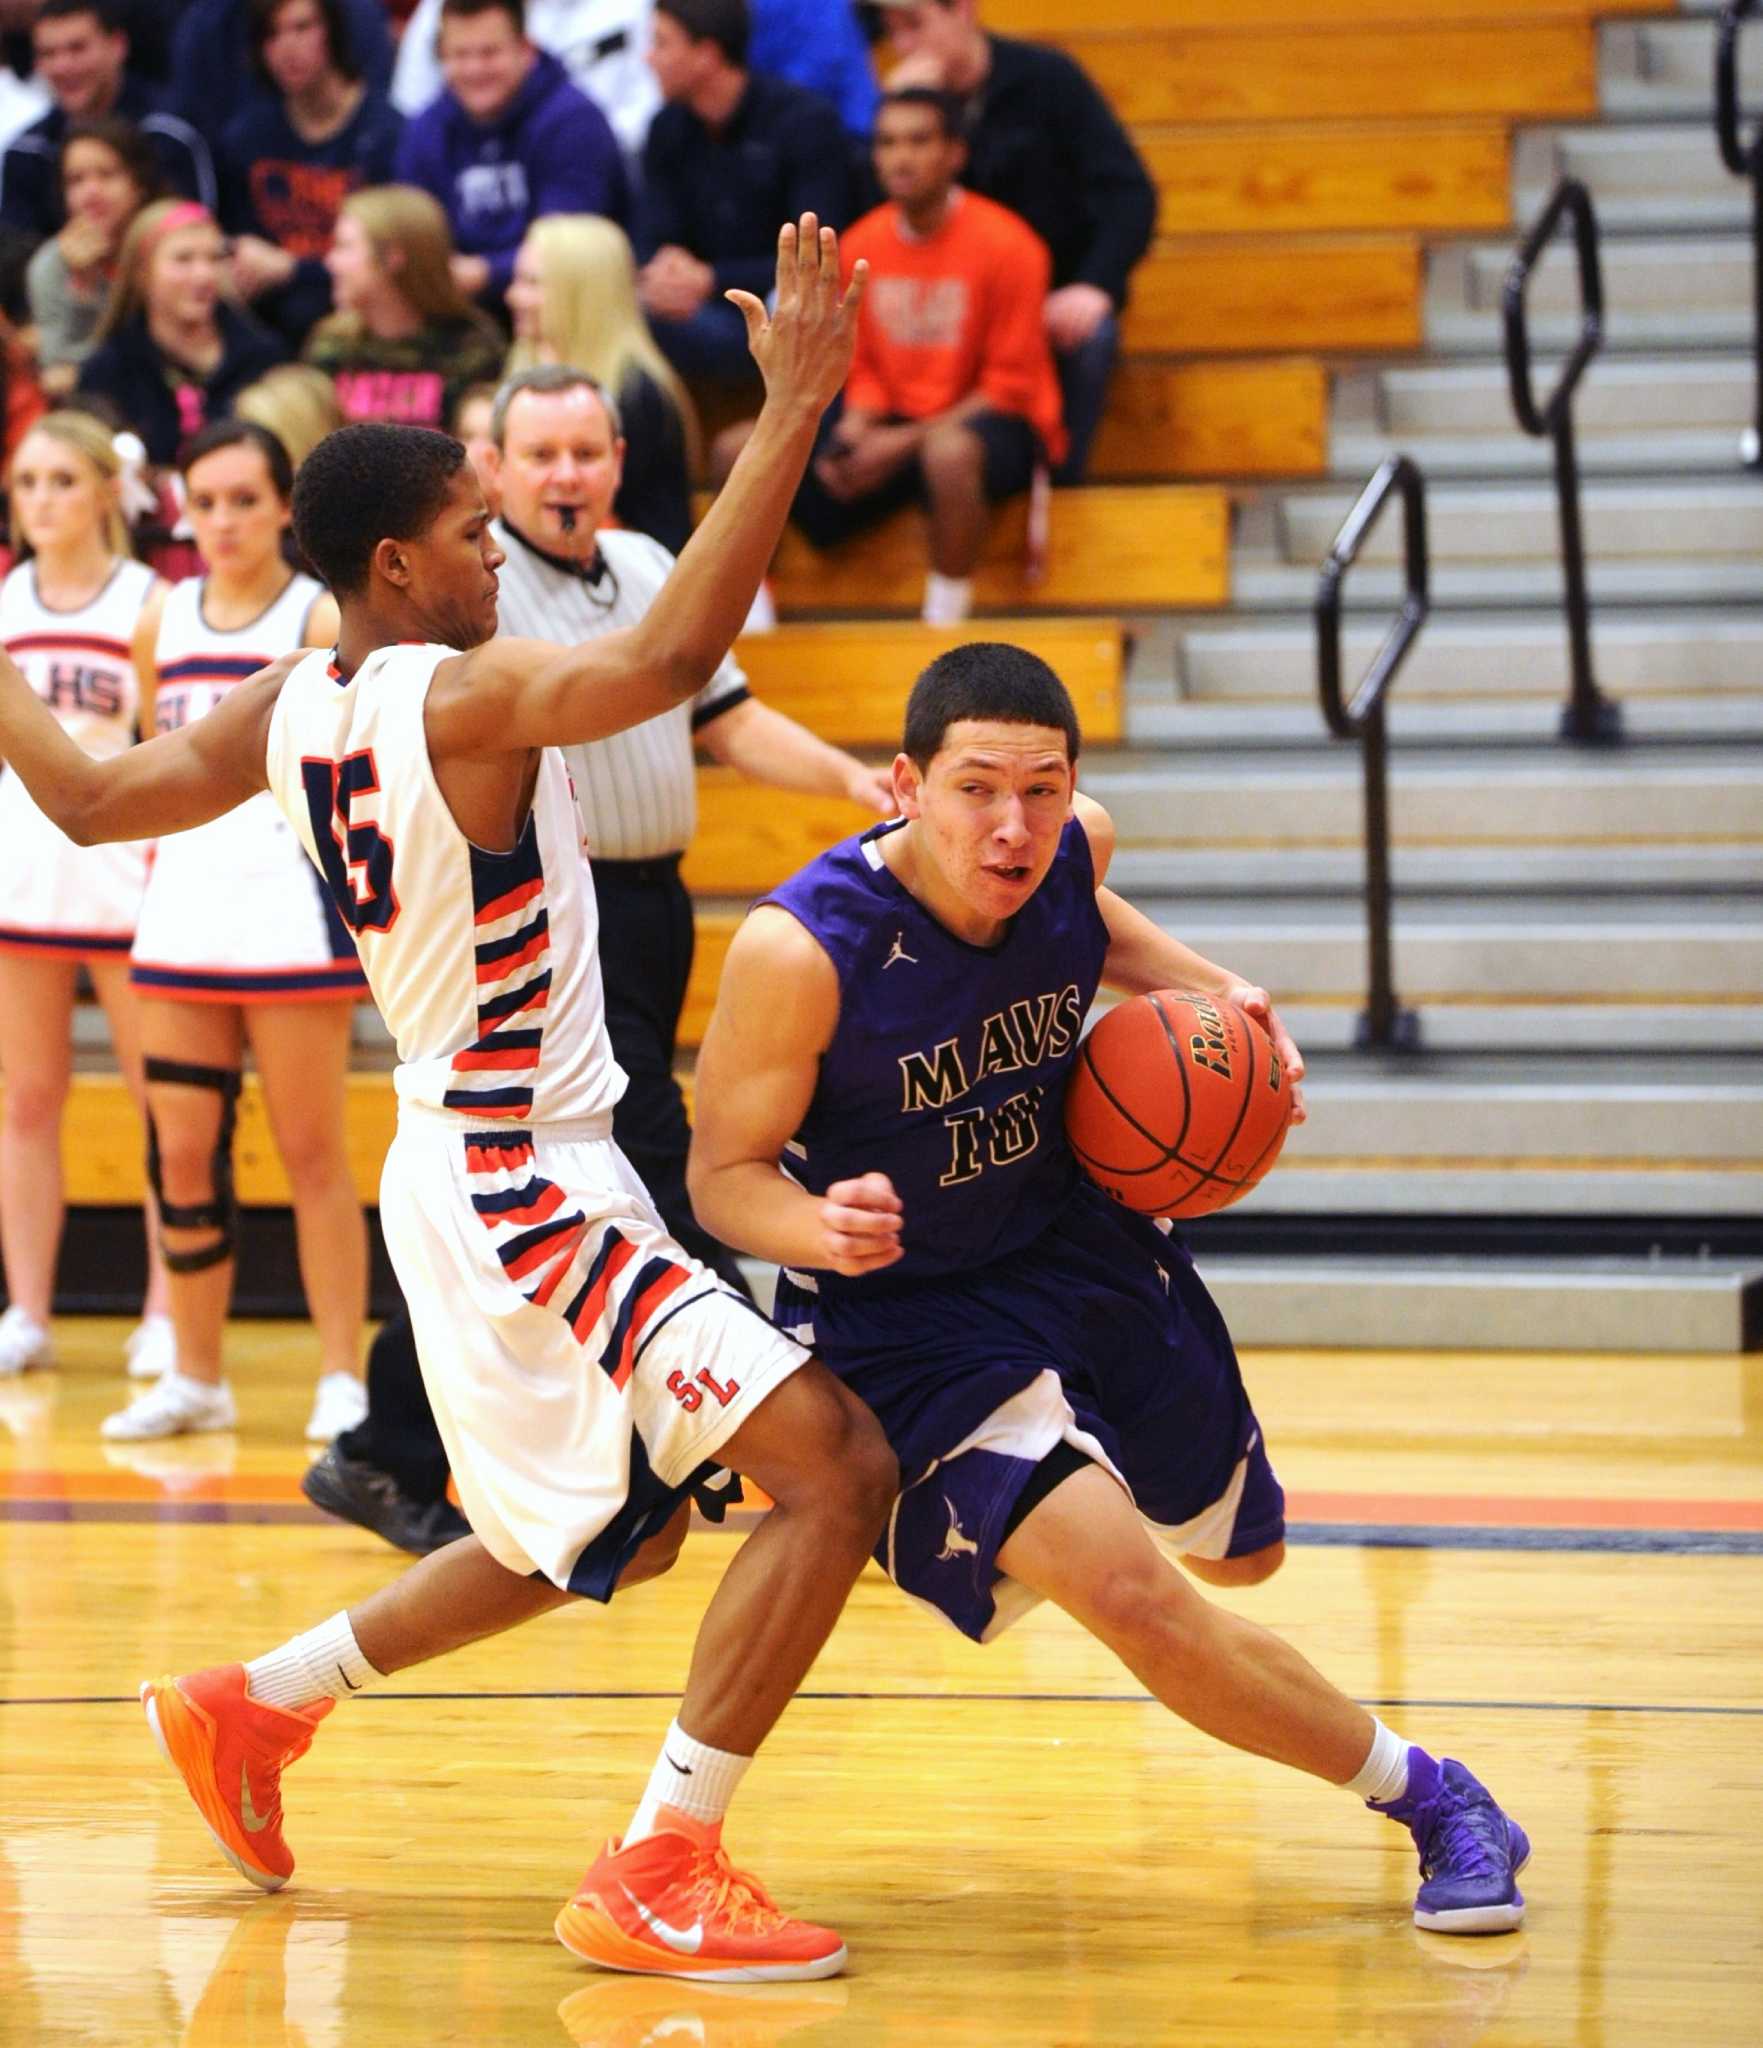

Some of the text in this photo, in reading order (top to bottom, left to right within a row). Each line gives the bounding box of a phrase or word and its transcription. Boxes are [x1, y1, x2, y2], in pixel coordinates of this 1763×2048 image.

[24, 662, 123, 718] HS
[300, 747, 402, 937] 15
[898, 984, 1081, 1112] MAVS
[666, 1366, 741, 1414] SL
